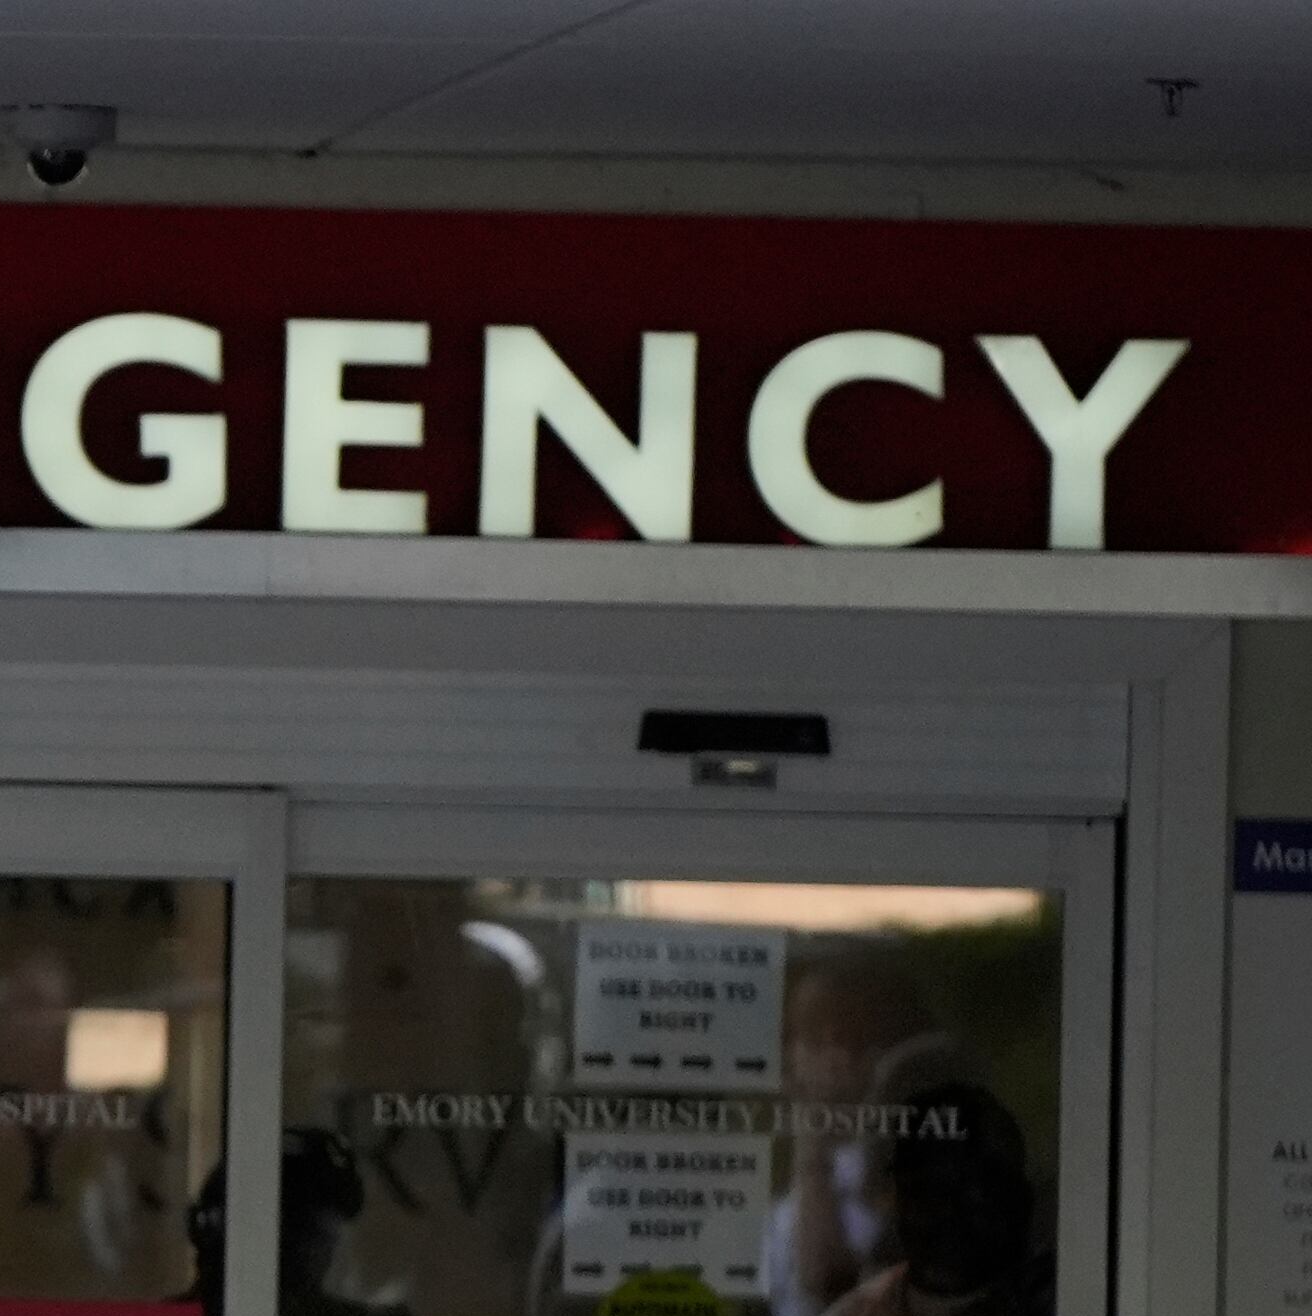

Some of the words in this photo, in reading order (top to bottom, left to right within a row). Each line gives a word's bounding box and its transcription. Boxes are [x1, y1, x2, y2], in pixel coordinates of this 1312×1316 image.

[1253, 840, 1312, 873] Ma
[589, 942, 659, 962] DOOR
[667, 944, 769, 968] BROKEN
[600, 976, 641, 999] USE
[650, 978, 716, 1001] DOOR
[723, 981, 758, 1003] TO
[639, 1009, 714, 1033] RIGHT
[371, 1091, 513, 1129] EMORY
[524, 1095, 763, 1136] UNIVERSITY
[774, 1100, 968, 1140] HOSPITAL
[576, 1152, 647, 1172] DOOR
[656, 1152, 756, 1172] BROKEN
[588, 1187, 630, 1208] USE
[638, 1187, 705, 1209] DOOR
[712, 1188, 745, 1209] TO
[630, 1219, 702, 1241] RIGHT
